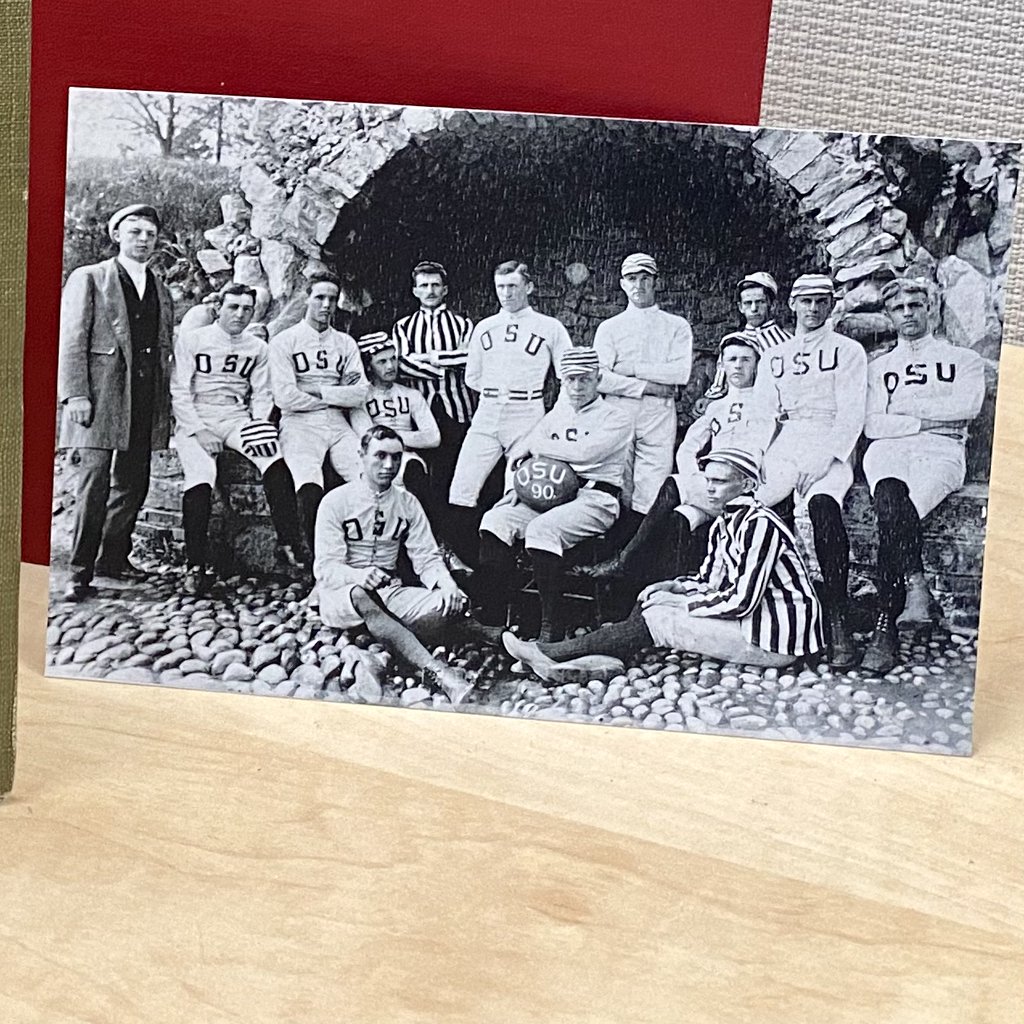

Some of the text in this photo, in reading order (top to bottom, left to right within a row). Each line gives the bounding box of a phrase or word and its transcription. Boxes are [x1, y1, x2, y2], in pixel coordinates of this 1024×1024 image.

[480, 324, 545, 356] OSU
[195, 353, 256, 377] OSU
[770, 347, 839, 378] OSU
[884, 362, 956, 394] OSU
[366, 396, 409, 418] OSU
[516, 462, 566, 486] OSU
